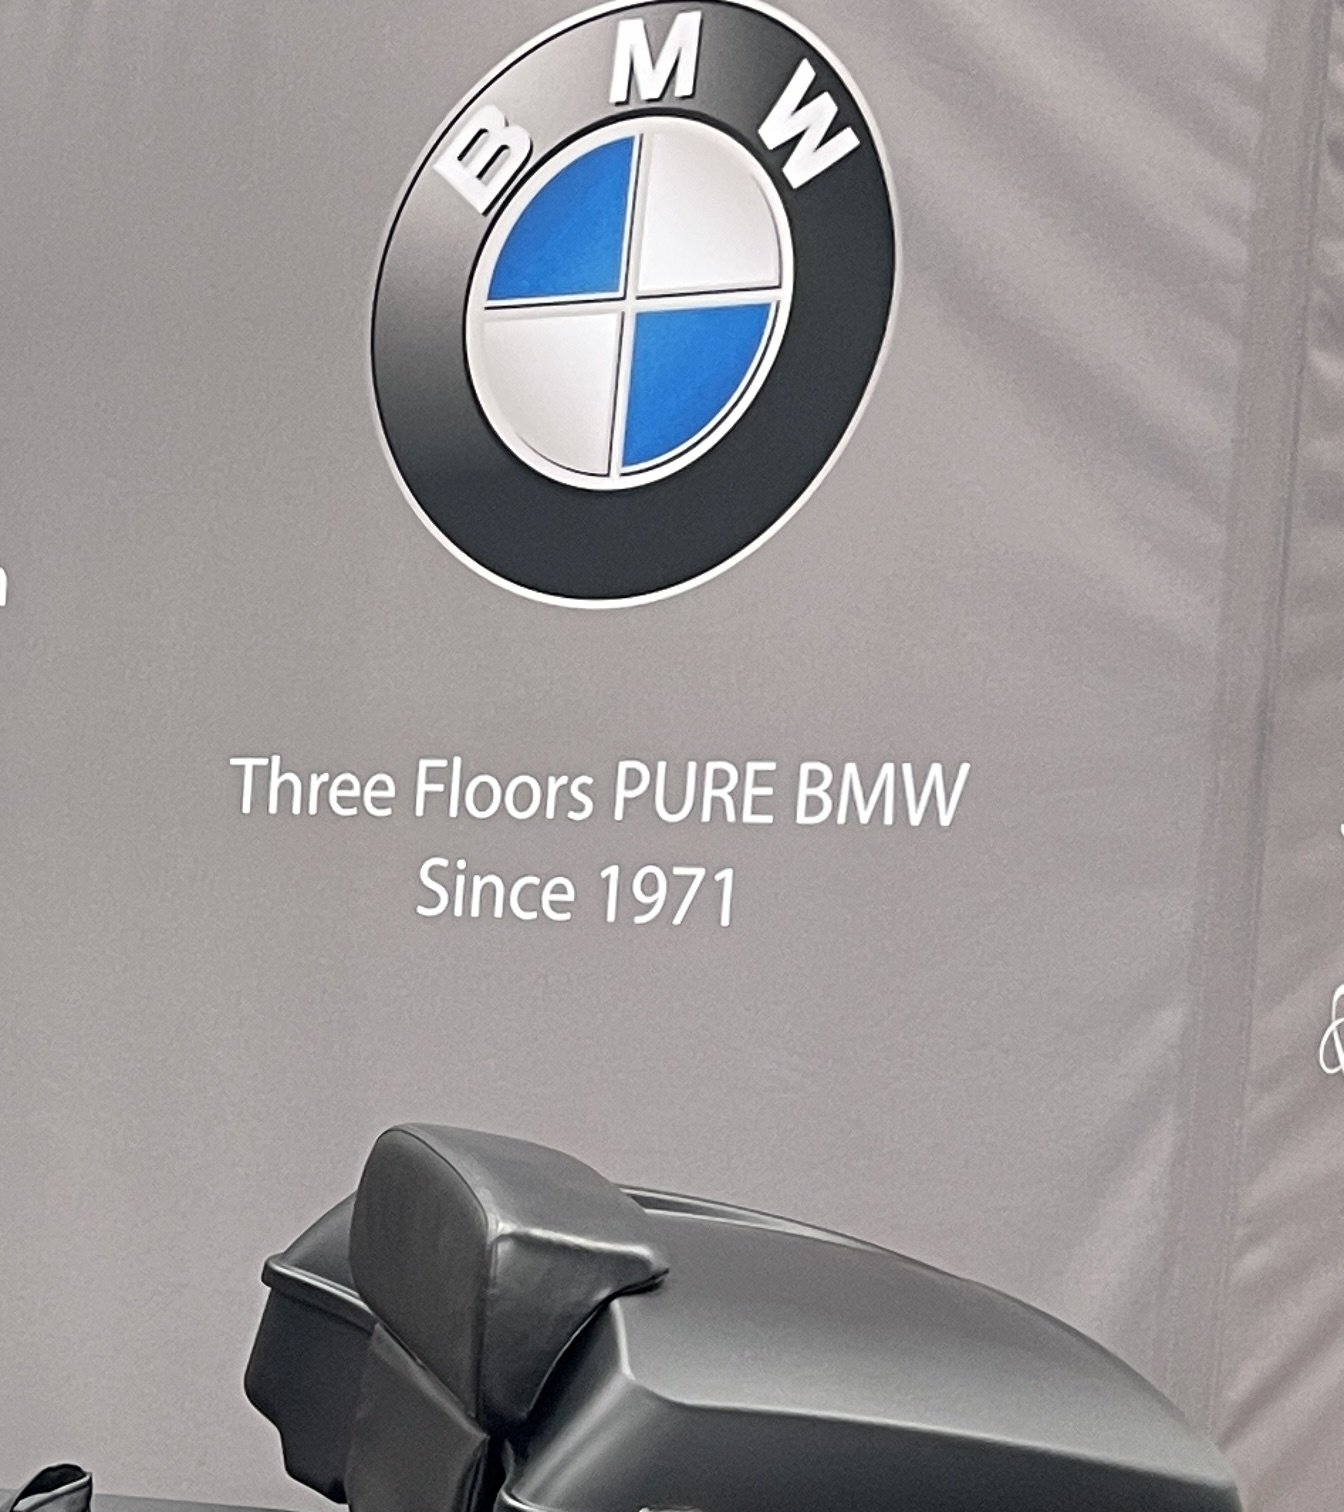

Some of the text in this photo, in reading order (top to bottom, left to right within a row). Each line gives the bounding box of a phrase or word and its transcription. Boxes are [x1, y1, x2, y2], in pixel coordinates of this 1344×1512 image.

[432, 11, 860, 214] BMW
[229, 754, 971, 827] Three Floors PURE BMW
[416, 857, 735, 927] Since 1971
